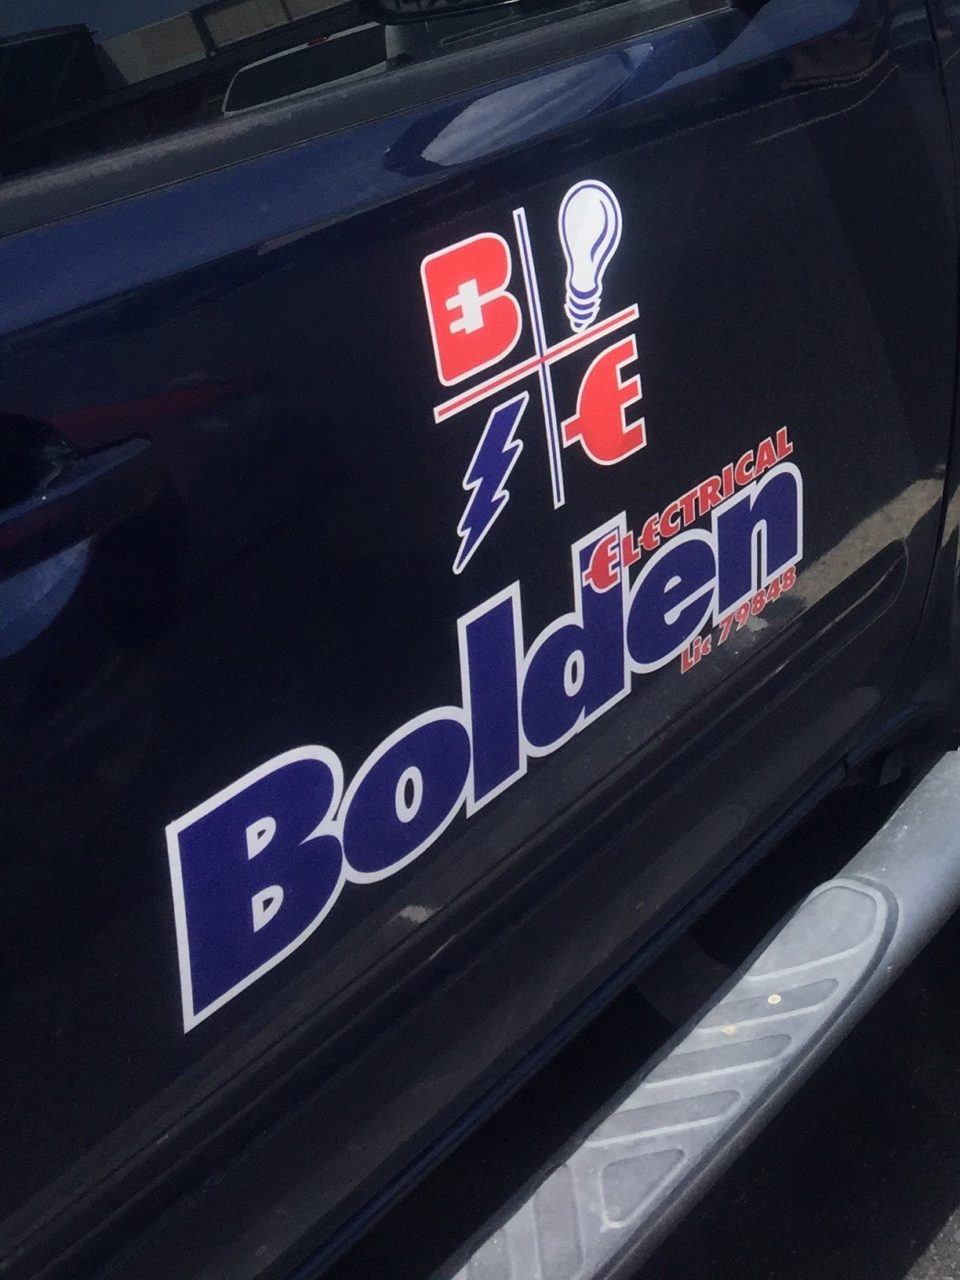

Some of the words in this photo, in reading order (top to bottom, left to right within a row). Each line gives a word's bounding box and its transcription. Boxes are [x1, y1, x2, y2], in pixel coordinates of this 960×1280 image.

[582, 425, 794, 594] ELECTRICAL
[680, 634, 712, 675] Lic
[717, 564, 797, 646] 79848
[165, 461, 803, 1033] Bolden
